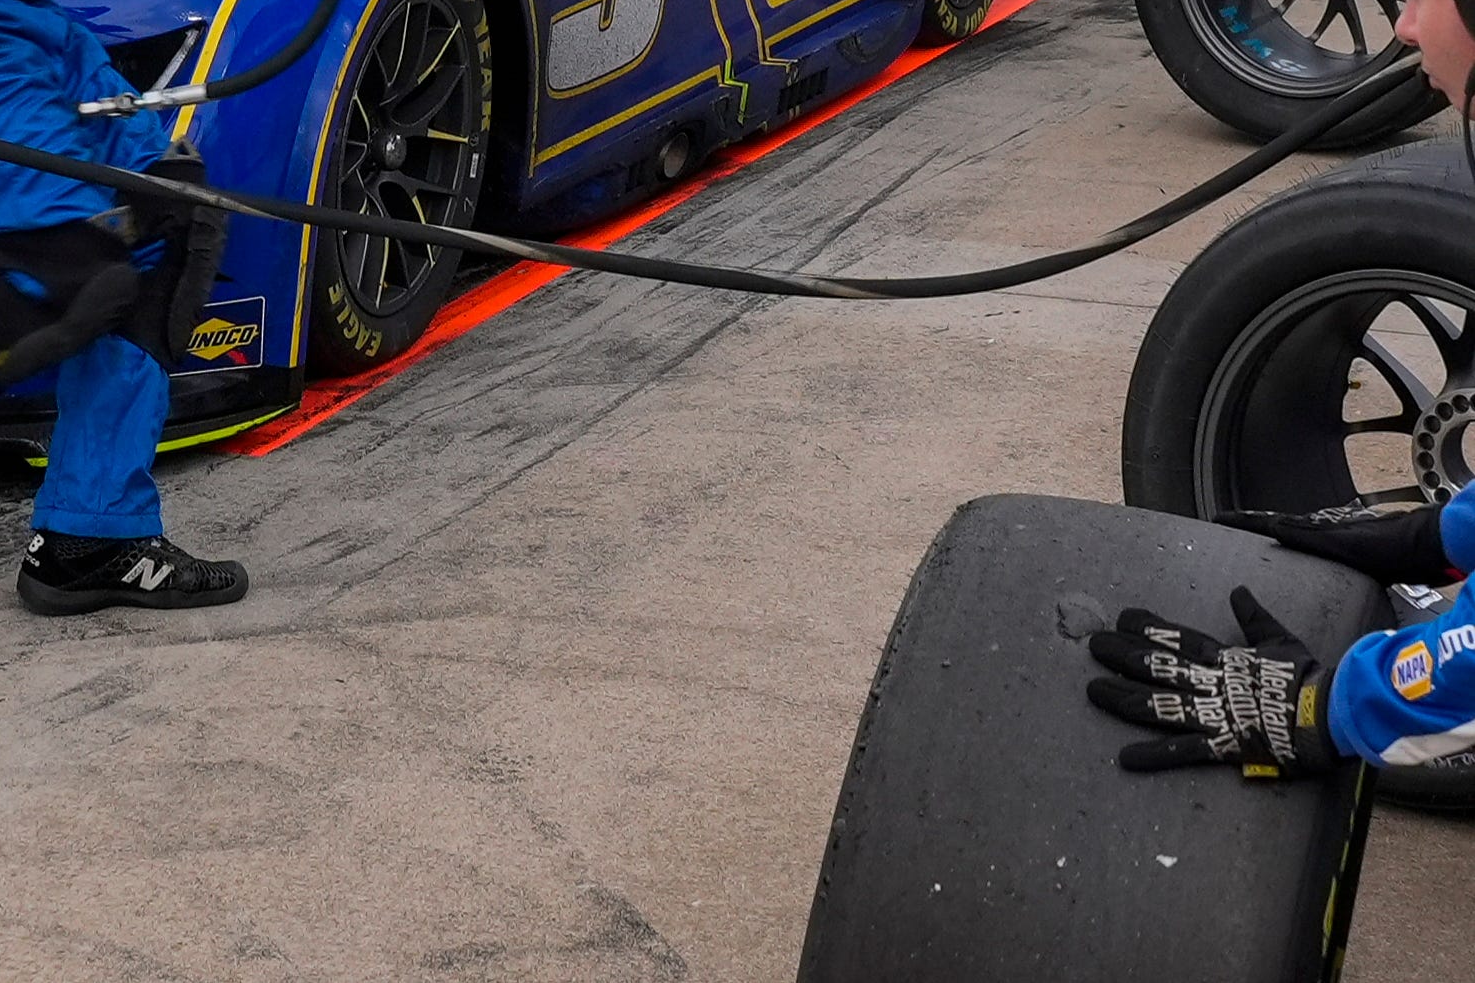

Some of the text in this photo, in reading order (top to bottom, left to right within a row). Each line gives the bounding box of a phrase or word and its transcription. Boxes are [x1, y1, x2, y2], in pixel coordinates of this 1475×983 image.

[328, 279, 382, 358] EAGLE
[186, 323, 260, 353] UNOCO
[120, 556, 175, 592] N
[1397, 653, 1428, 686] NAPA
